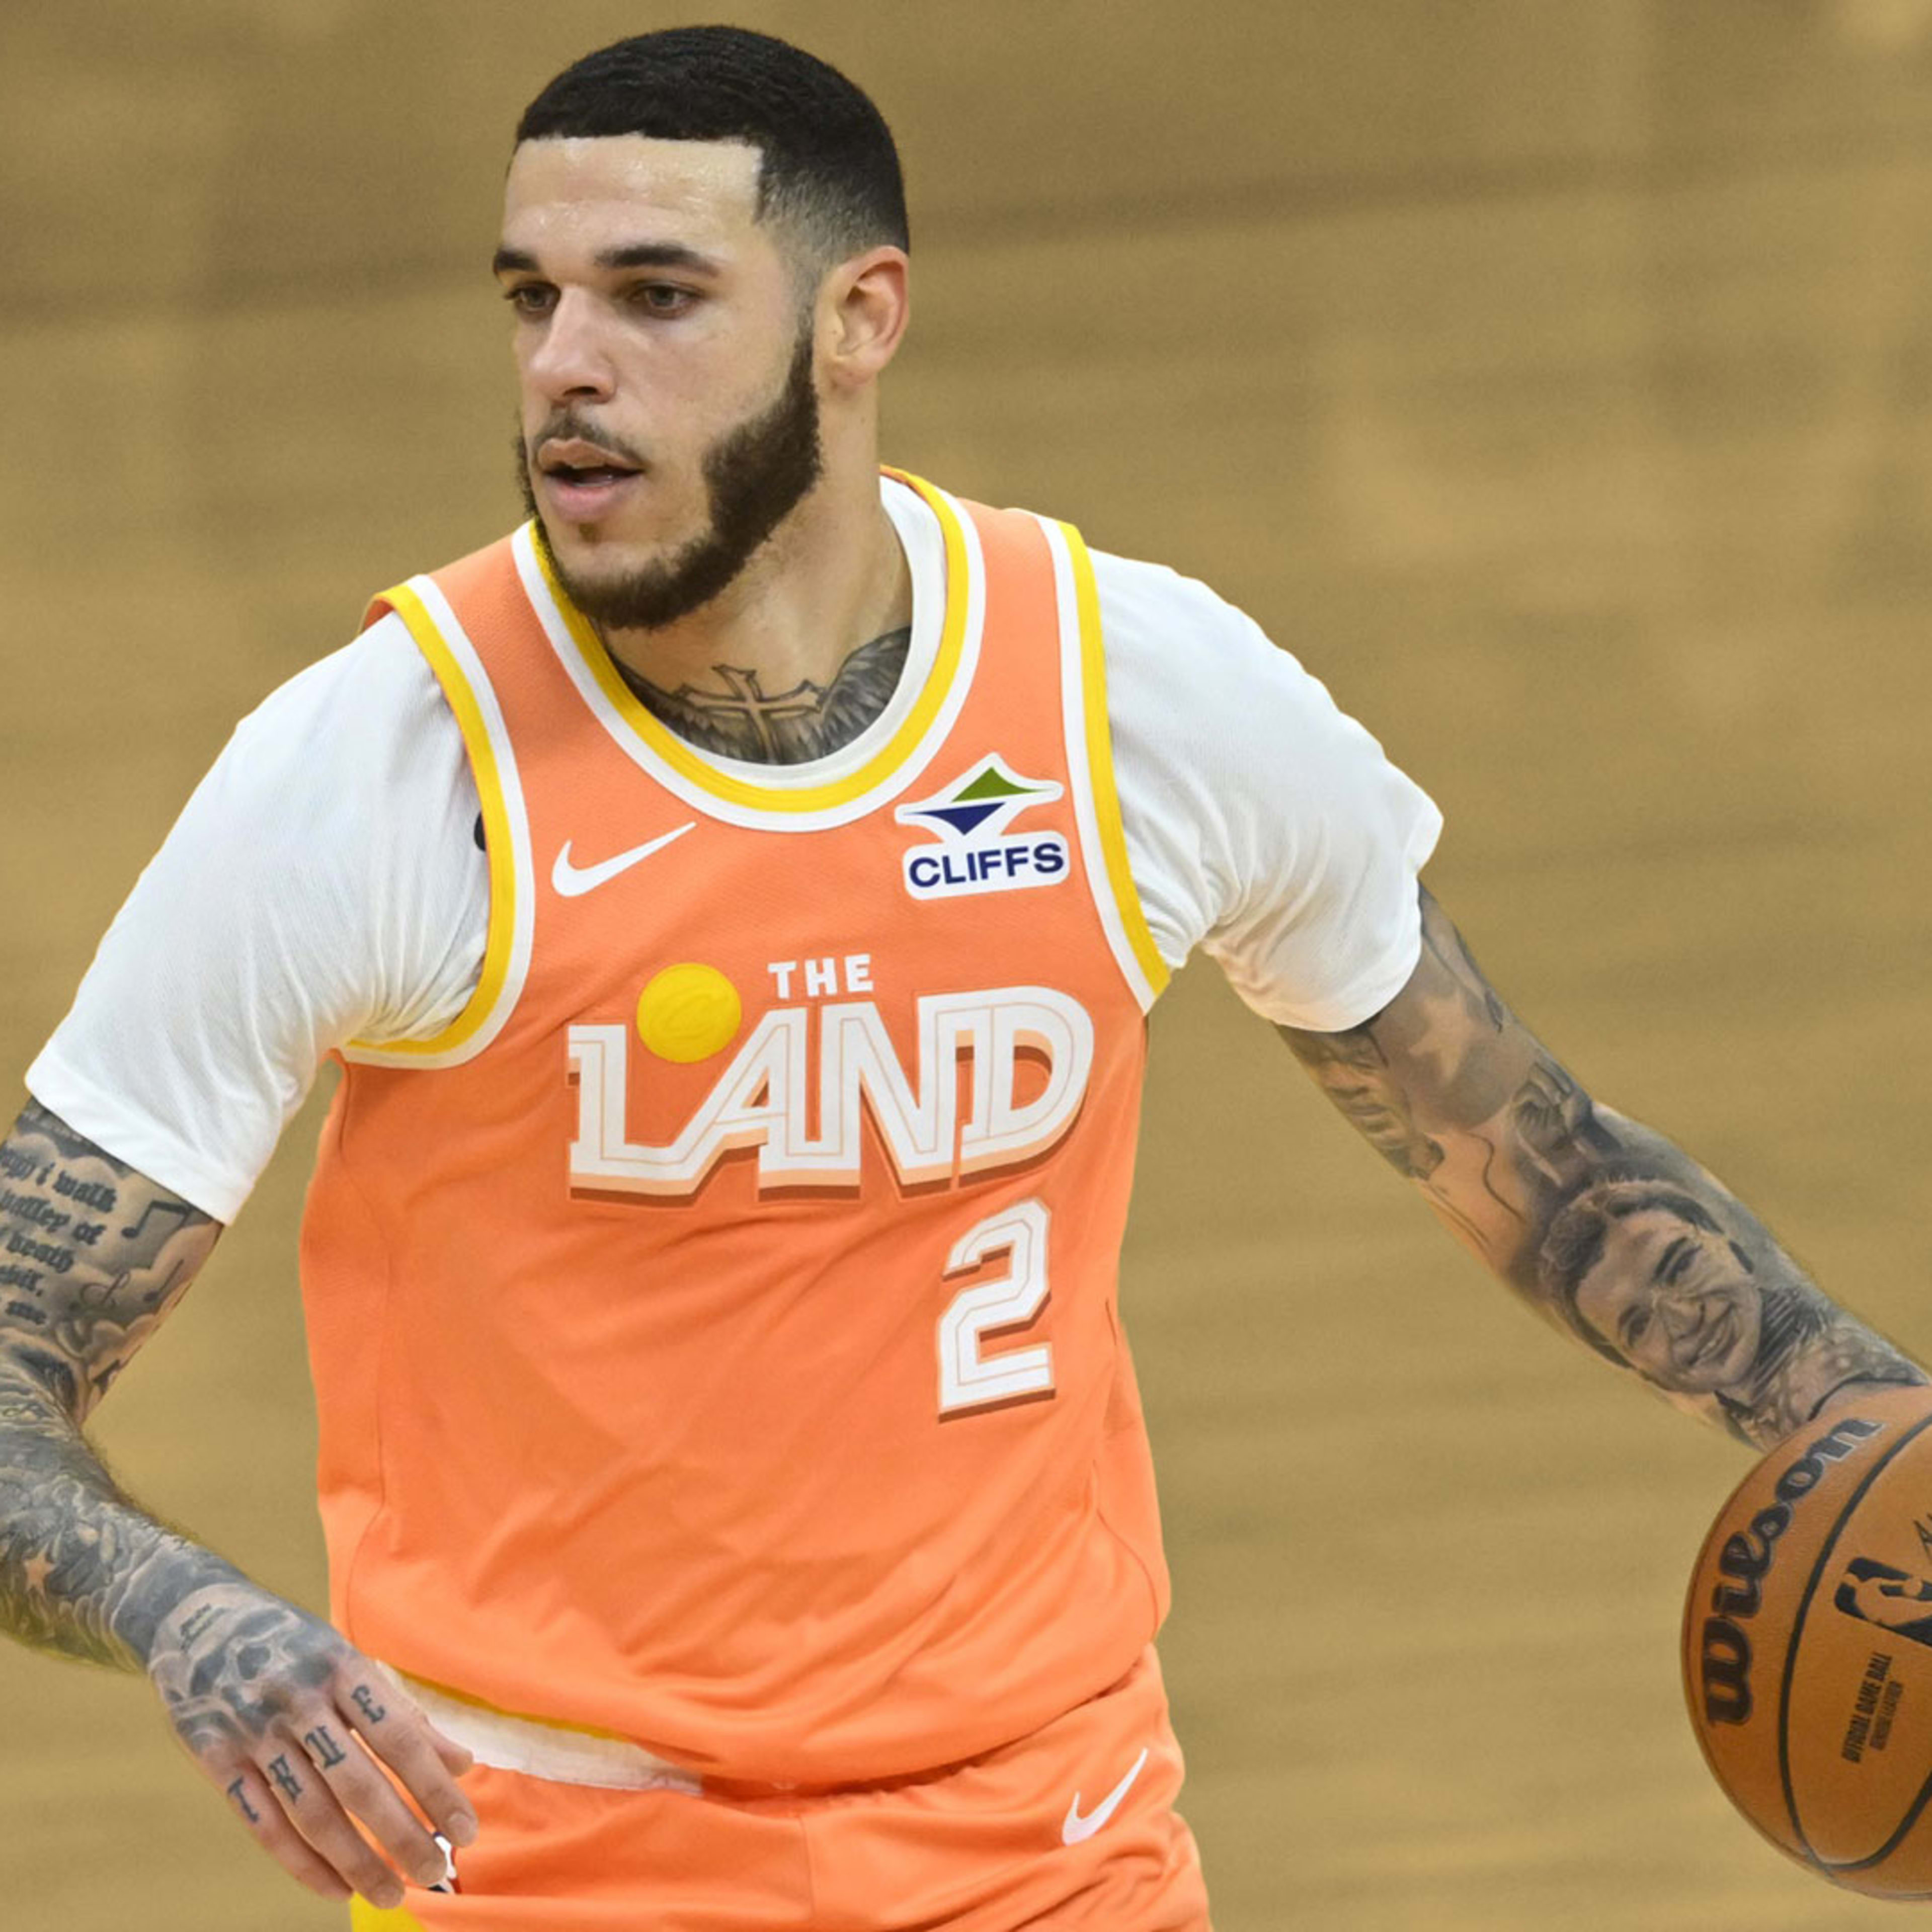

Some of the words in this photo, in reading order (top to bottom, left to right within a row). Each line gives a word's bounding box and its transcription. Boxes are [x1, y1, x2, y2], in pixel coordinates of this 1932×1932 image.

[908, 843, 1064, 888] CLIFFS
[767, 954, 874, 999] THE
[568, 985, 1095, 1205] LAND
[937, 1196, 1056, 1424] 2
[1702, 1418, 1886, 1728] Wilson
[1865, 1651, 1892, 1681] BALL
[1855, 1679, 1882, 1714] GAME
